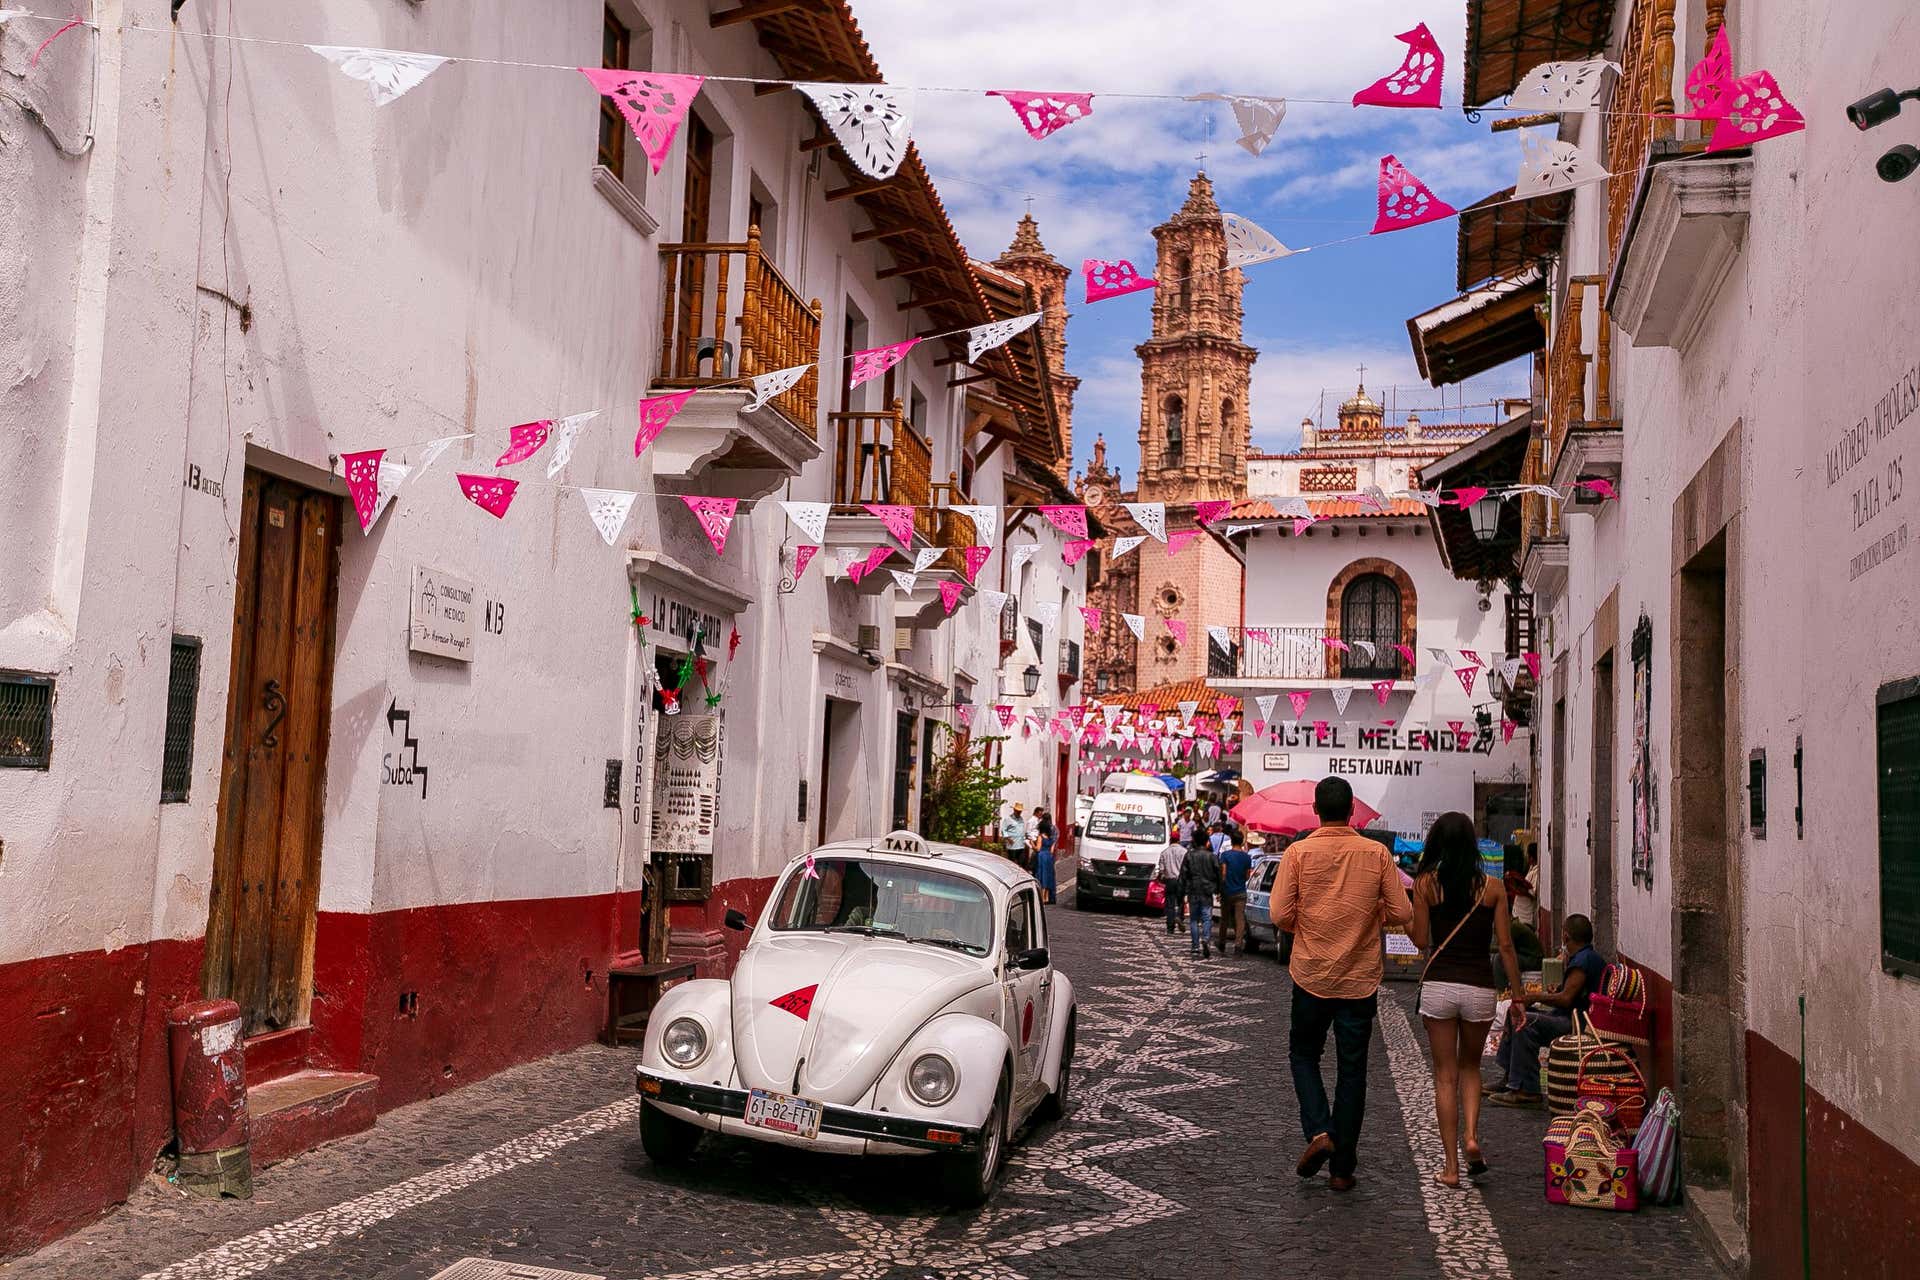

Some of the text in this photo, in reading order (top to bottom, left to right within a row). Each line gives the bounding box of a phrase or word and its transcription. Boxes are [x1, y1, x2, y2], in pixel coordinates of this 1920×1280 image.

[1852, 473, 1881, 532] PLATA
[652, 594, 666, 632] LA
[382, 752, 413, 786] Suba
[633, 684, 647, 825] MAYOREO
[713, 707, 727, 829] MENUDEO
[1329, 757, 1423, 777] RESTAURANT
[1115, 802, 1143, 812] RUFFO
[885, 837, 919, 853] TAXI
[751, 1098, 818, 1128] 61-82-FFN
